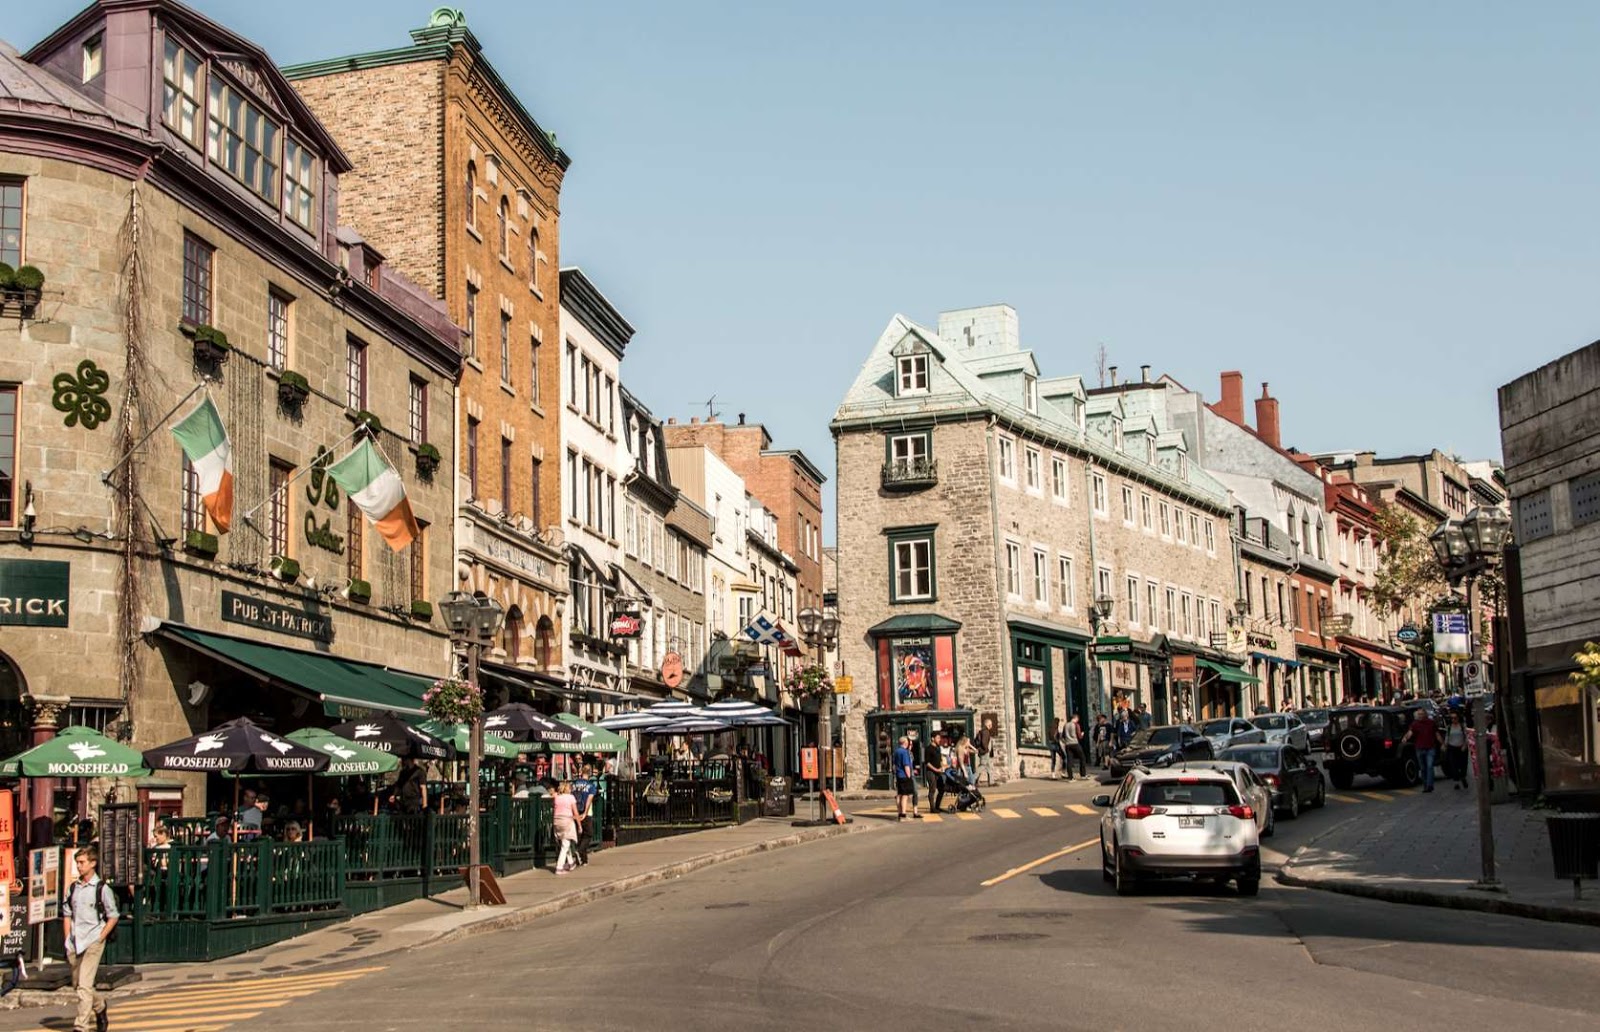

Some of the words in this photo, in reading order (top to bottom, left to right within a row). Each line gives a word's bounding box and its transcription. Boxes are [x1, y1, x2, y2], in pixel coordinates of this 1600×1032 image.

[164, 756, 232, 768] MOOSEHEAD
[265, 757, 315, 768] MOOSEHEAD
[48, 763, 129, 774] MOOSEHEAD
